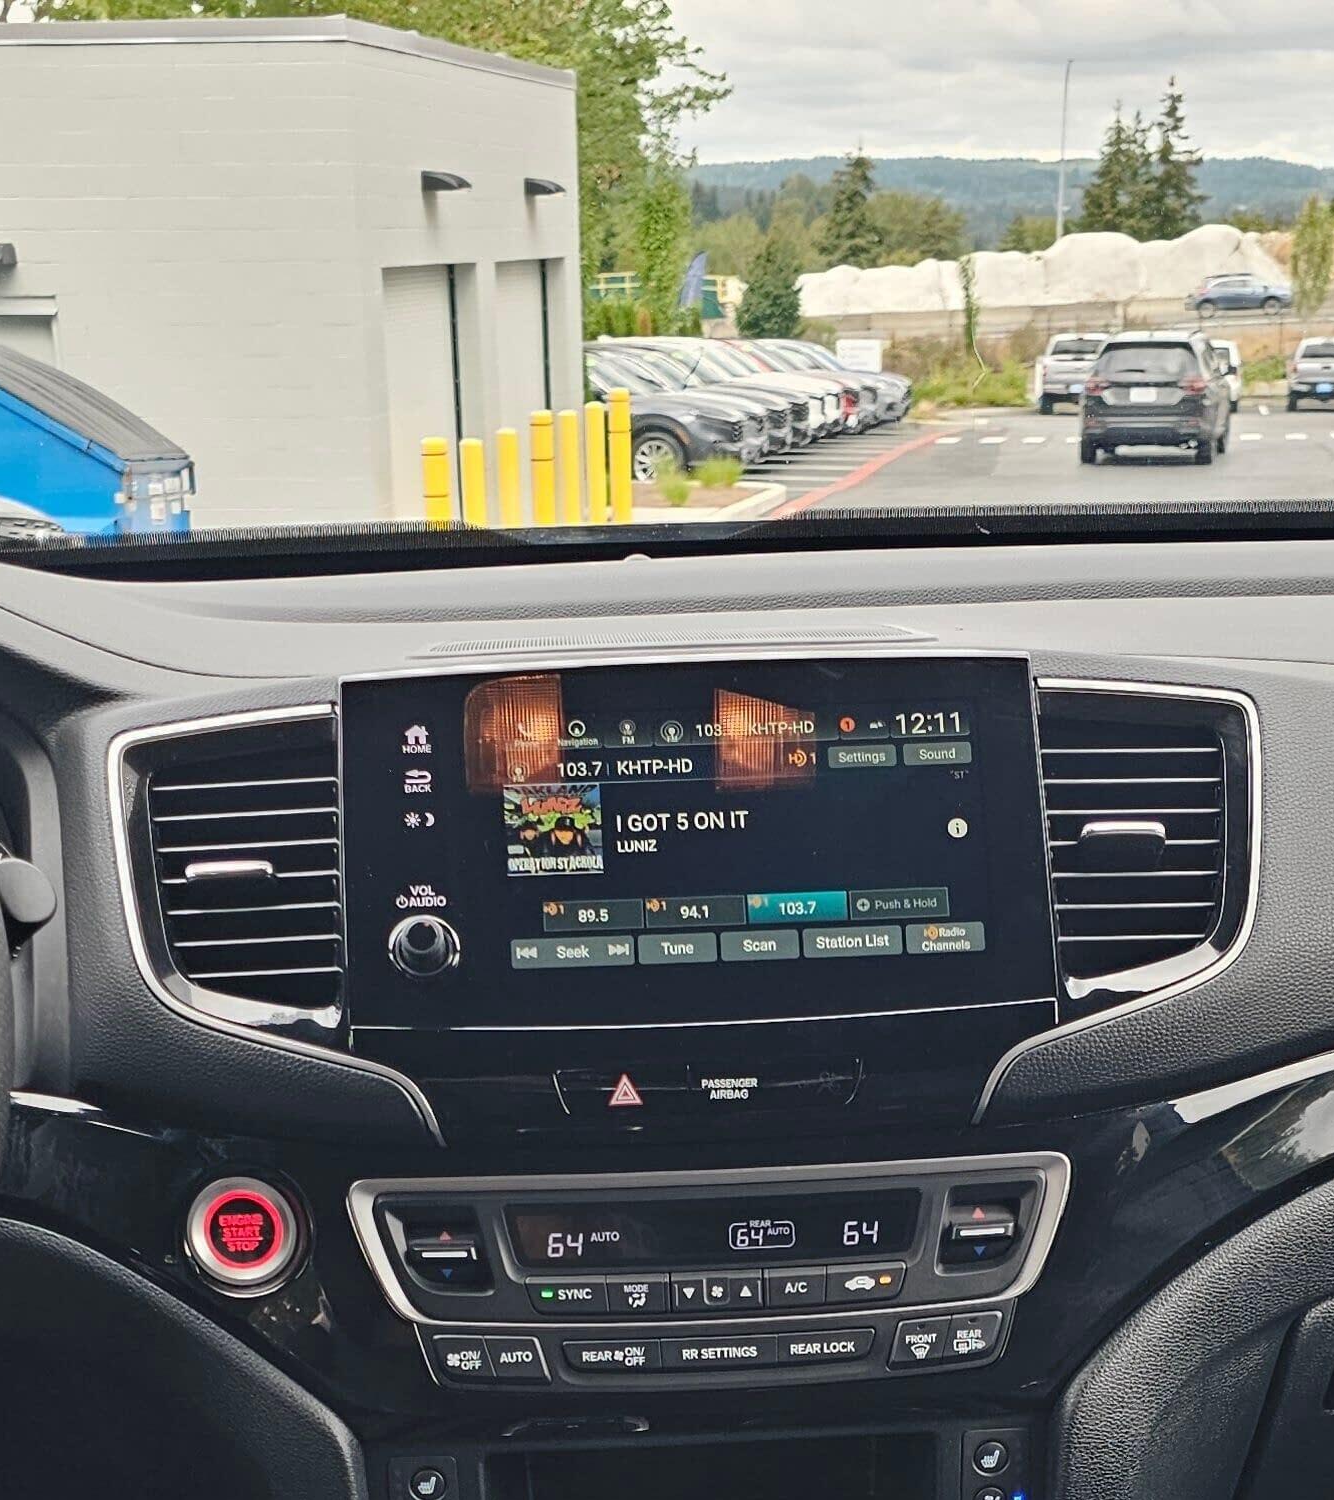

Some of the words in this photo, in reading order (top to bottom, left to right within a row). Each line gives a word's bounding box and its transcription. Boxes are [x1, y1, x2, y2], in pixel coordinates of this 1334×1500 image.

[895, 711, 962, 735] 12:11
[558, 737, 599, 749] Navigation
[621, 736, 635, 745] FM
[402, 743, 432, 754] HOME
[919, 748, 956, 761] Sound
[838, 751, 886, 765] Settings
[557, 761, 602, 777] 103.7
[616, 758, 693, 776] KHTP-HD
[404, 783, 432, 794] BACK
[616, 815, 622, 833] I
[627, 813, 671, 832] GOT
[677, 812, 689, 831] 5
[694, 811, 725, 830] ON
[730, 810, 749, 829] IT
[616, 839, 658, 854] LUNIZ
[409, 884, 435, 896] VOL
[409, 895, 447, 908] AUDIO
[874, 900, 901, 910] Push
[903, 899, 911, 909] &
[913, 898, 937, 909] Hold
[578, 908, 609, 923] 89.5
[679, 905, 709, 919] 94.1
[778, 901, 817, 917] 103.7
[939, 927, 966, 937] Radio
[661, 941, 694, 955] Tune
[743, 939, 777, 952] Scan
[816, 935, 863, 949] Station
[865, 934, 890, 948] List
[922, 940, 971, 952] Channels
[556, 945, 590, 960] Seek
[701, 1077, 759, 1090] PASSENGER
[709, 1088, 749, 1100] AIRBAG
[749, 1219, 772, 1228] REAR
[222, 1225, 261, 1238] START
[736, 1227, 764, 1248] 64
[767, 1226, 790, 1237] AUTO
[843, 1220, 879, 1246] 64
[227, 1241, 260, 1252] STOP
[546, 1232, 584, 1258] 64
[590, 1231, 620, 1243] AUTO
[557, 1288, 593, 1300] SYNC
[623, 1283, 649, 1294] MODE
[784, 1281, 808, 1294] A/C
[905, 1333, 937, 1345] FRONT
[956, 1329, 982, 1340] REAR
[682, 1348, 699, 1360] RR
[701, 1346, 758, 1360] SETTINGS
[790, 1342, 823, 1355] REAR
[824, 1341, 856, 1354] LOCK
[499, 1351, 533, 1364] AUTO
[582, 1350, 613, 1363] REAR
[624, 1356, 646, 1367] OFF
[460, 1360, 482, 1371] OFF
